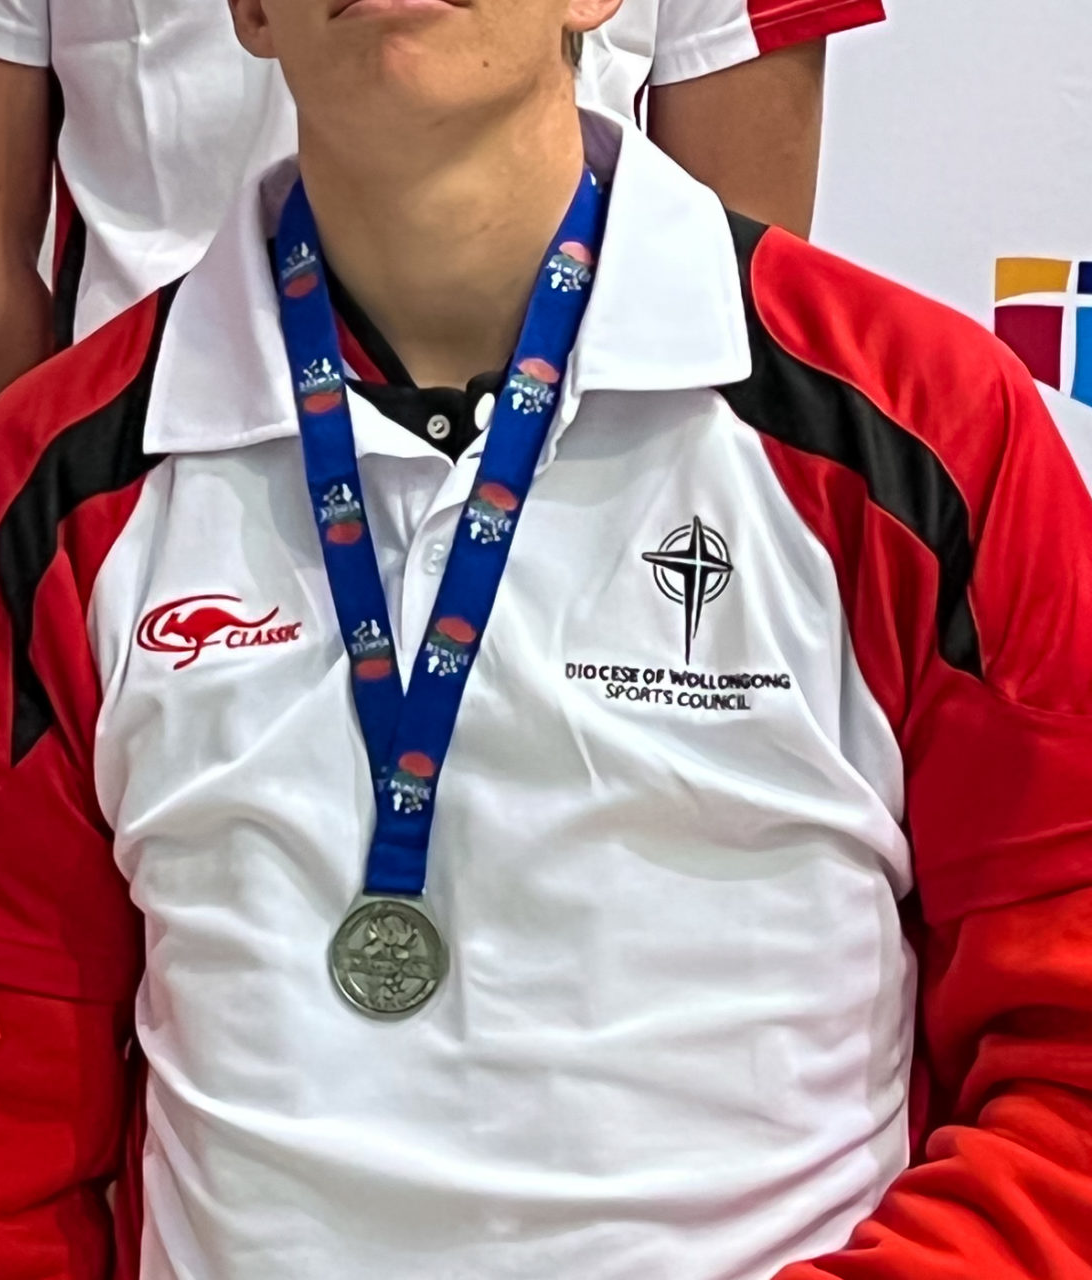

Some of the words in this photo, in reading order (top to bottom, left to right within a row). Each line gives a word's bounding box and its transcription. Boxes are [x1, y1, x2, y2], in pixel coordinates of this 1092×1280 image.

[226, 622, 302, 649] CLASSIC
[565, 662, 640, 683] DIOCESE
[642, 668, 665, 684] OF
[669, 669, 792, 690] WOLLONGONG
[605, 683, 673, 705] SPORTS
[677, 692, 751, 710] COUNCIL
